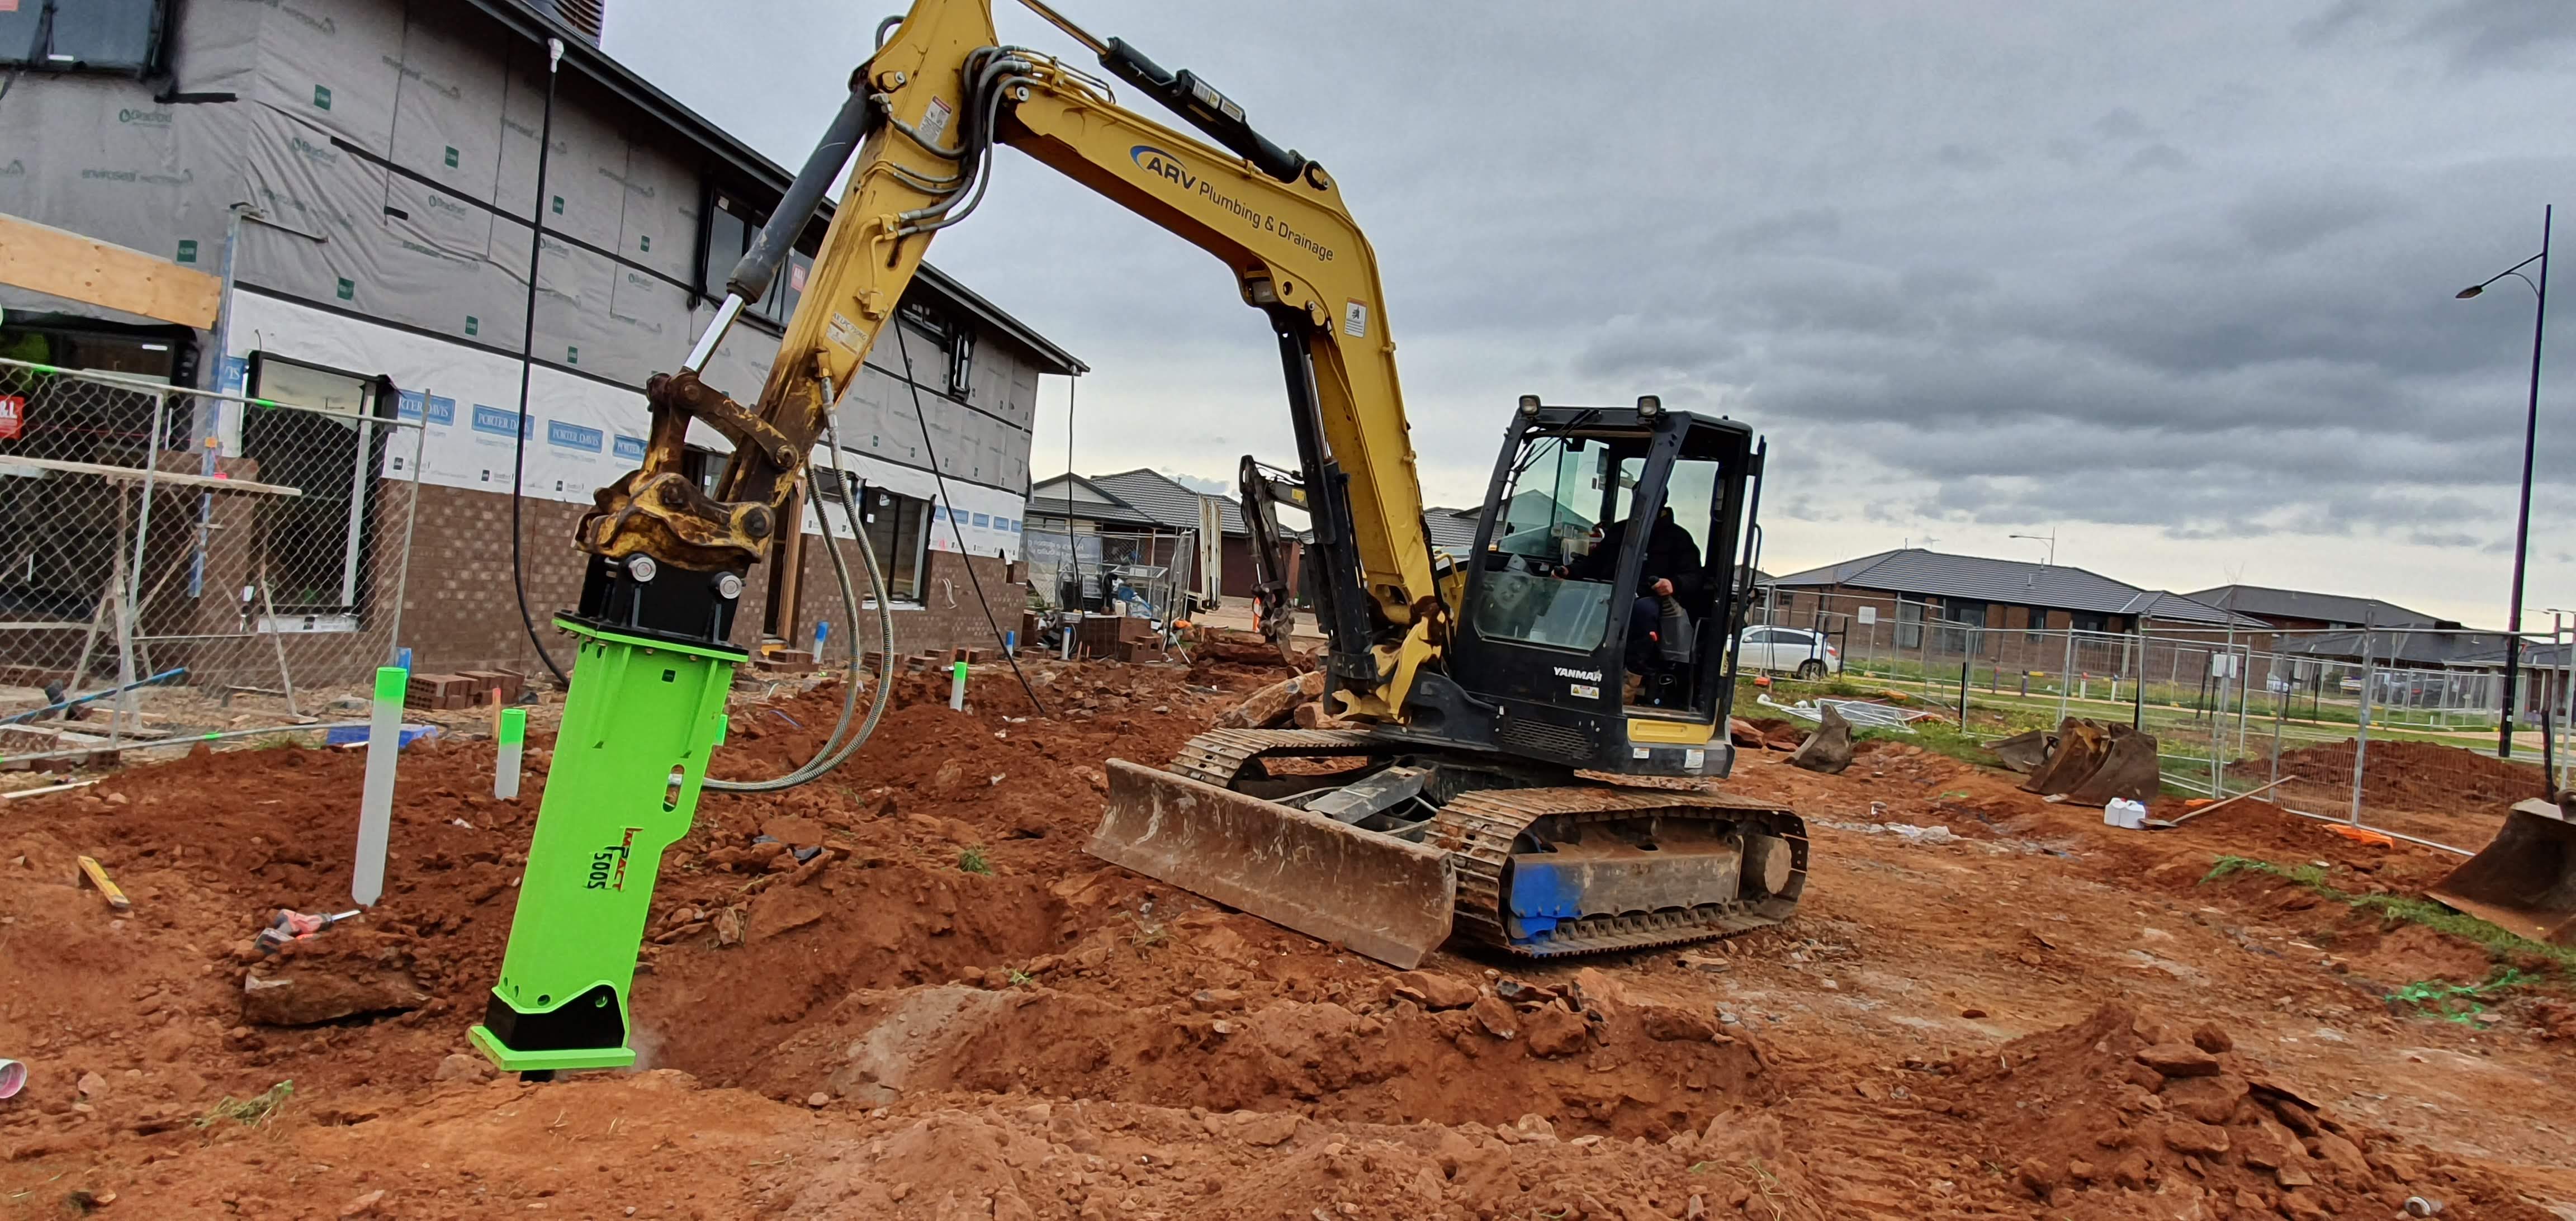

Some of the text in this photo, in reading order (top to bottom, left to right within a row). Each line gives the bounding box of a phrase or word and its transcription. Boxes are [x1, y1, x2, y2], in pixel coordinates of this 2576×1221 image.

[1147, 157, 1333, 261] ARV Plumbing & Drainage
[478, 413, 508, 428] PORTER
[553, 428, 599, 446] PORTER DAVIS
